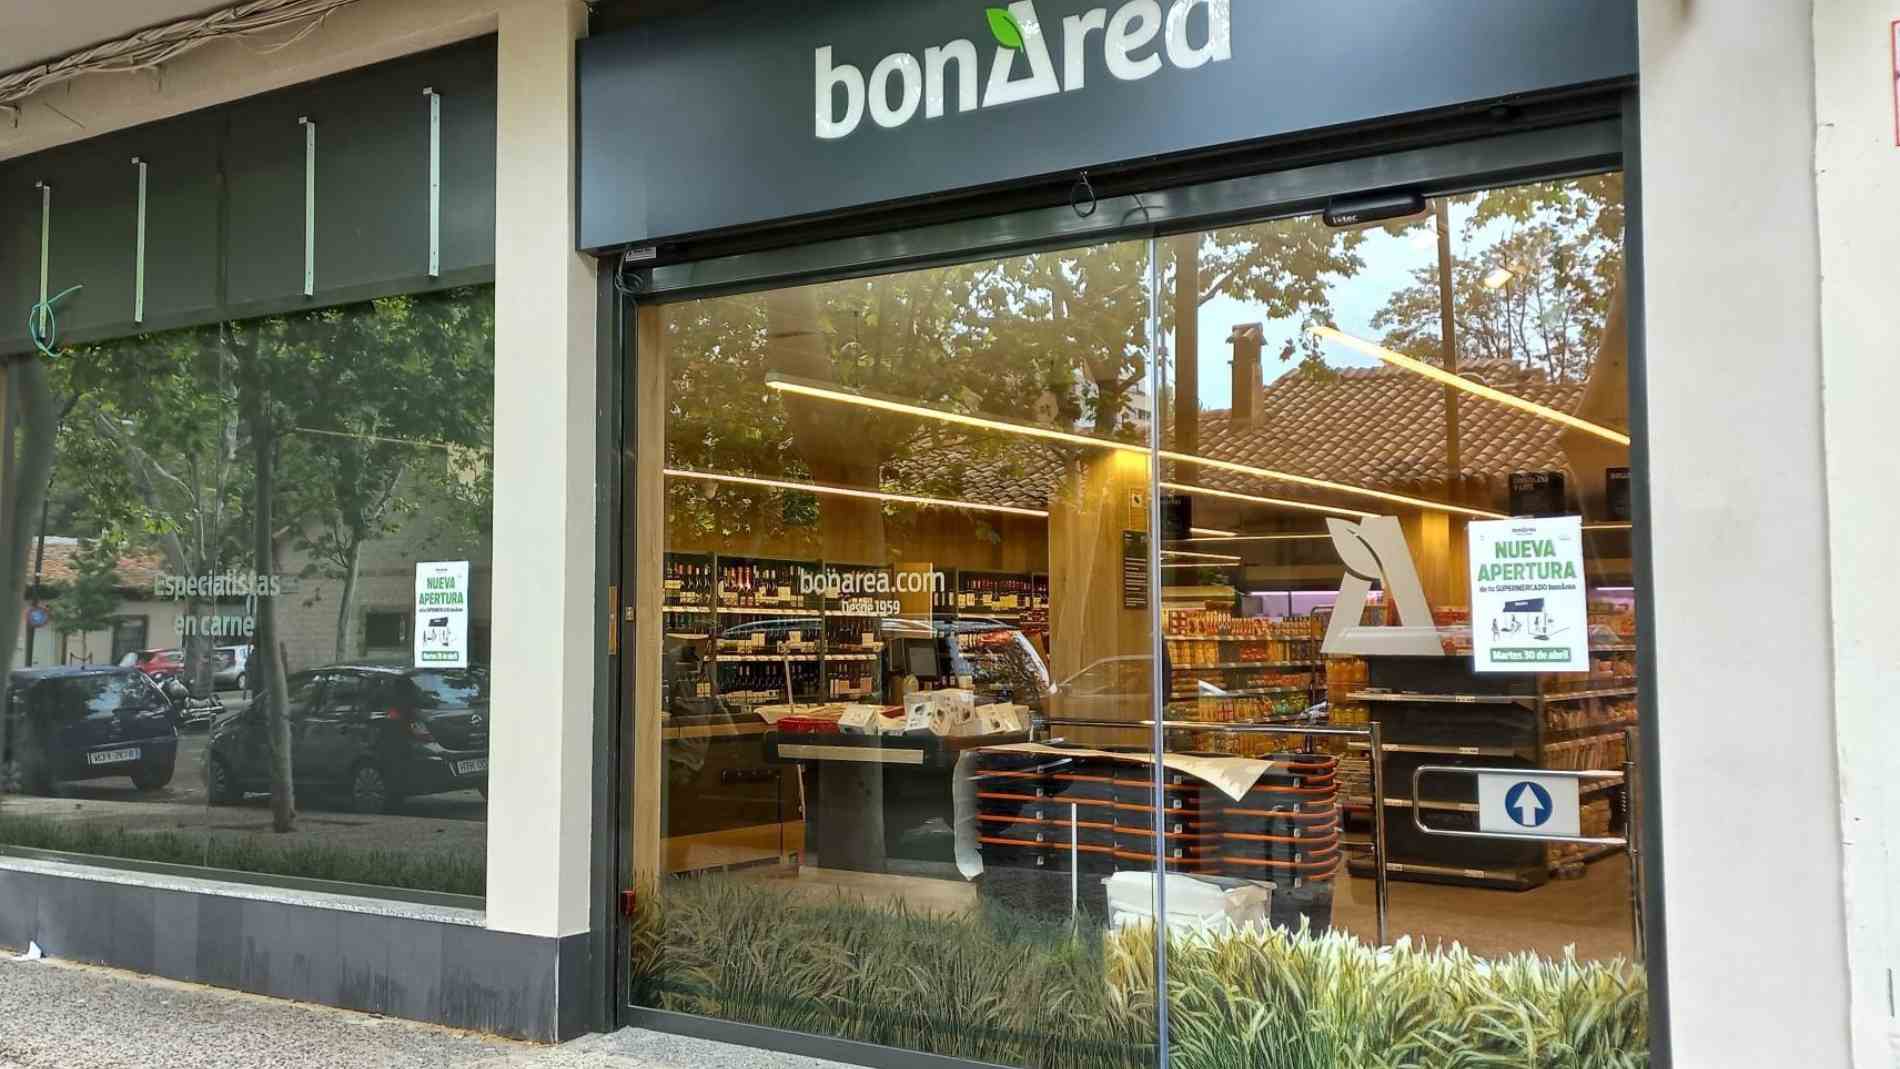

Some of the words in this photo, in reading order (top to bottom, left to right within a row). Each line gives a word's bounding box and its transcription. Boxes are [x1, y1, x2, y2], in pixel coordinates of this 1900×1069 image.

[1495, 539, 1556, 559] NUEVA
[800, 568, 945, 595] bonarea.com
[1477, 561, 1577, 582] APERTURA
[426, 575, 456, 590] NUEVA
[418, 591, 465, 605] APERTURA
[876, 599, 900, 615] 1959
[175, 614, 197, 636] en
[201, 614, 256, 637] carne
